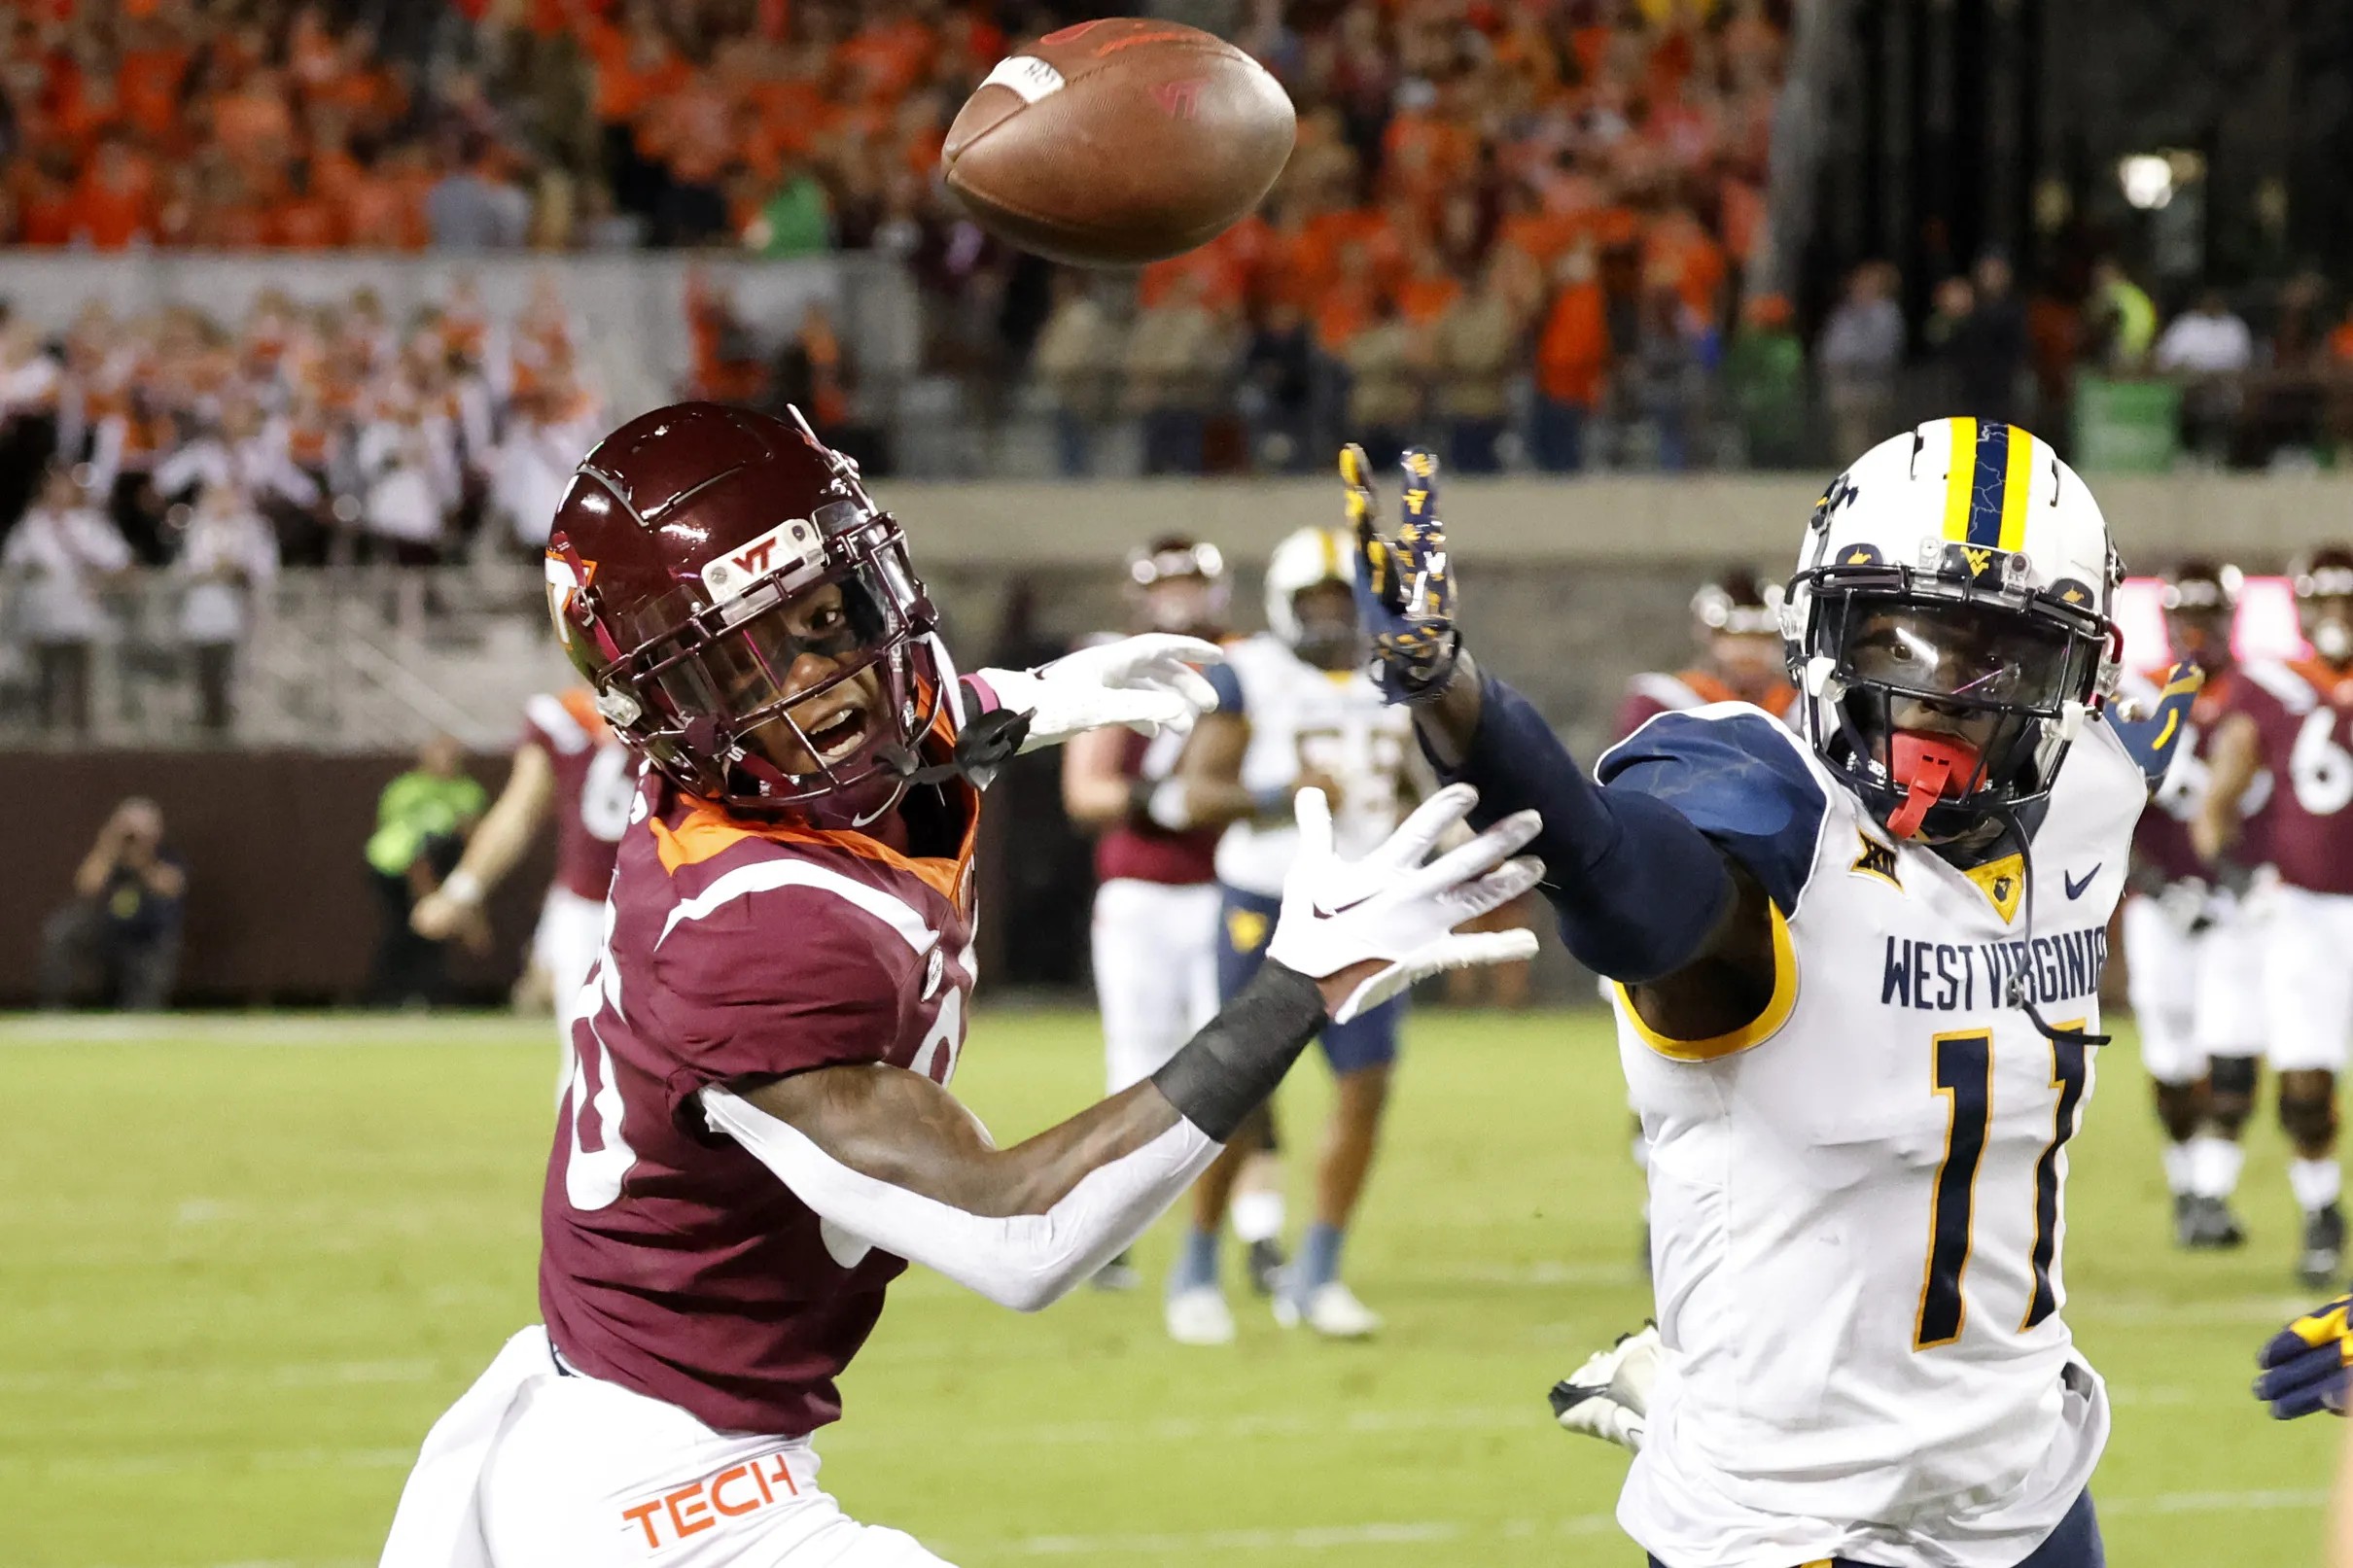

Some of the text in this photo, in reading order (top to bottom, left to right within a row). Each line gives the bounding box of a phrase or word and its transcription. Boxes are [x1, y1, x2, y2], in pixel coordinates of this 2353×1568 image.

[731, 536, 777, 575] VT
[1881, 935, 1974, 1011] WEST
[1913, 1017, 2088, 1354] 11
[622, 1453, 799, 1549] TECH
